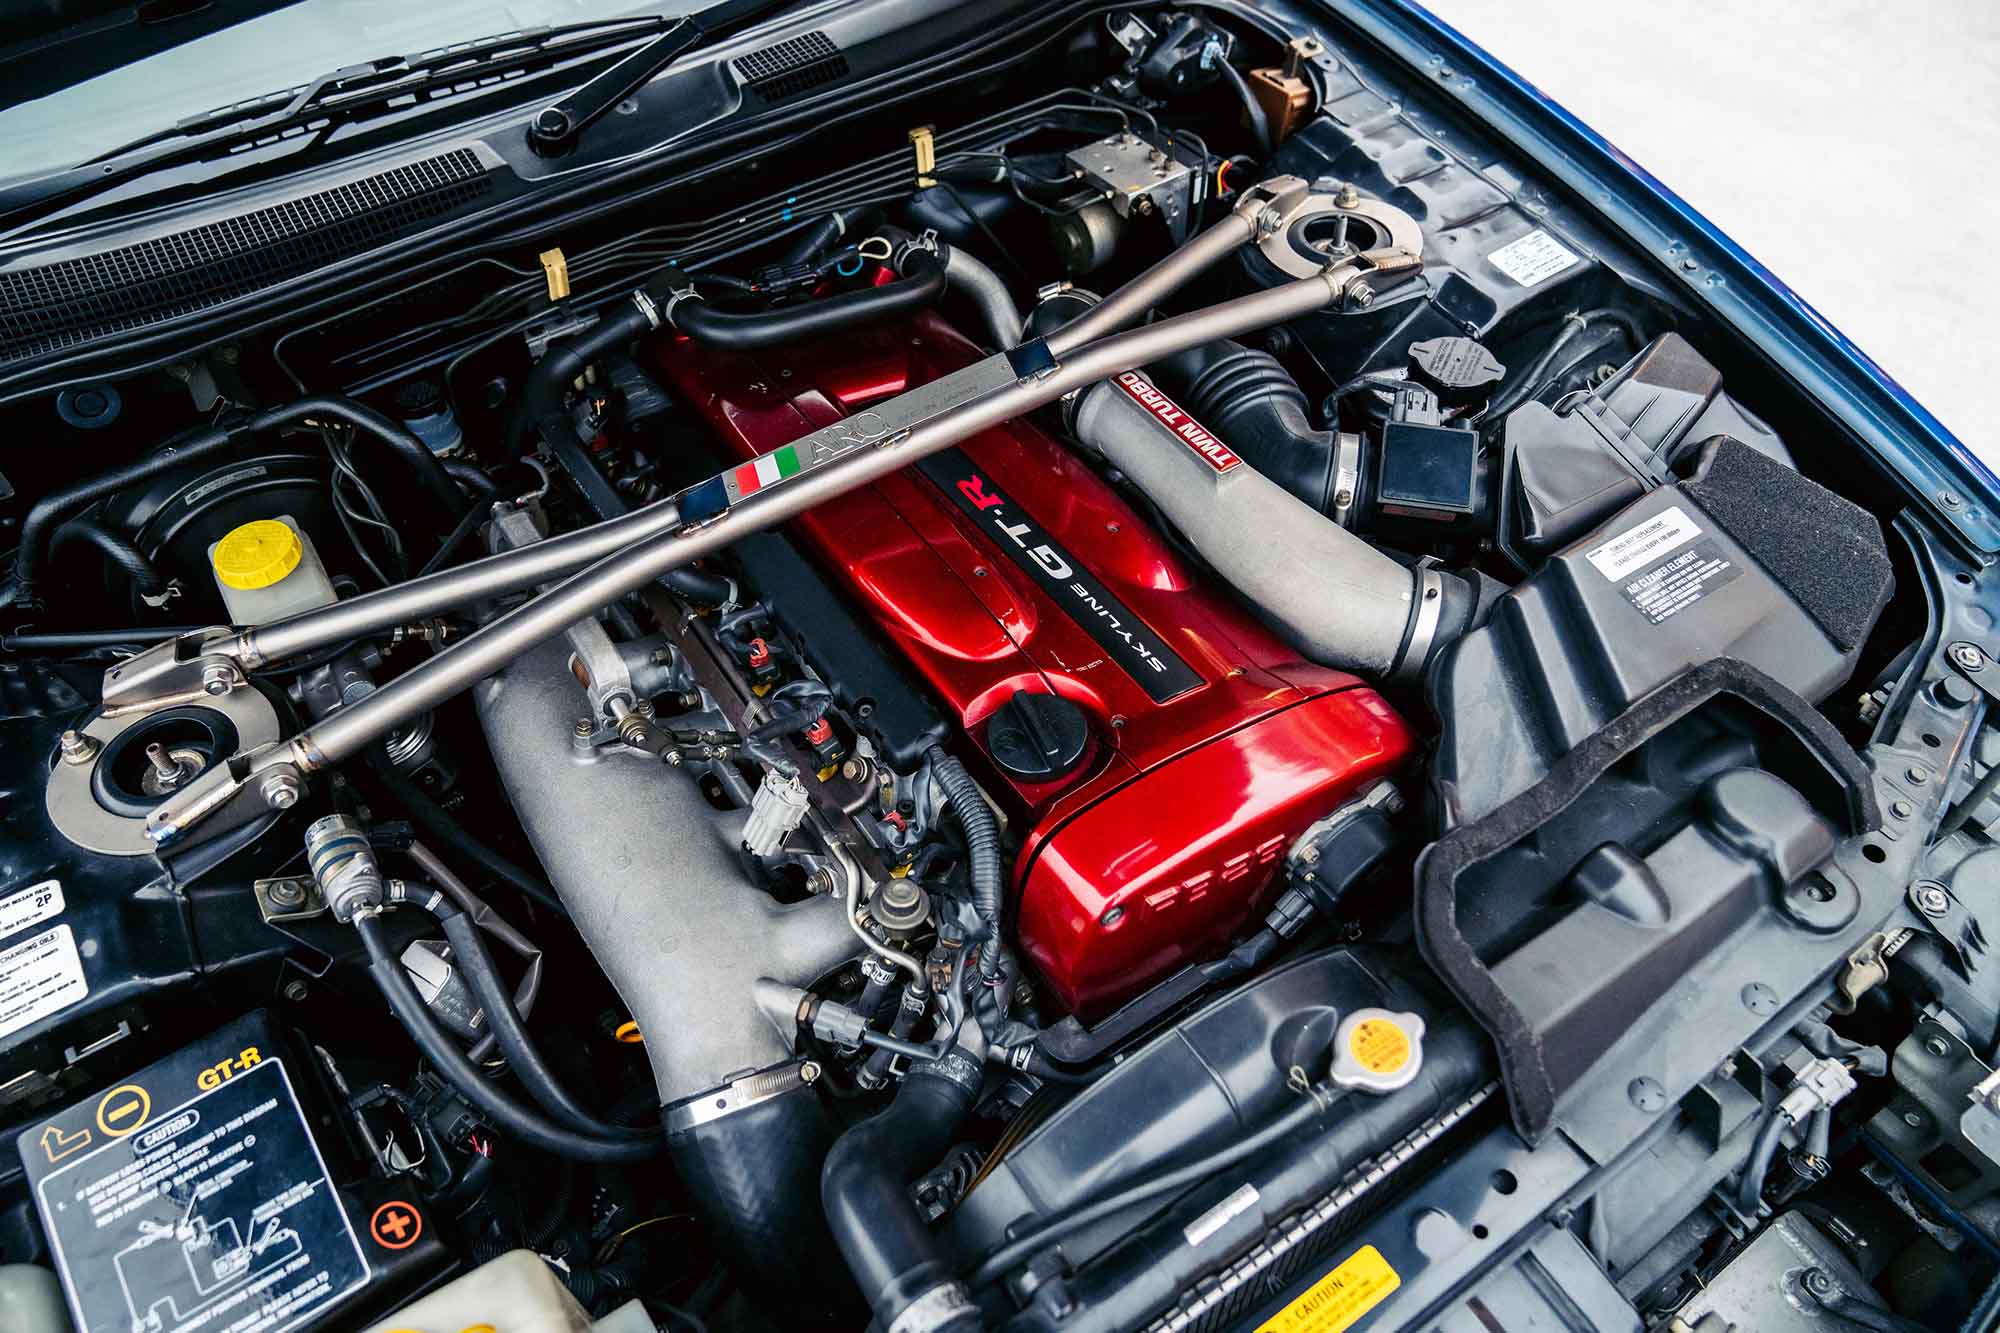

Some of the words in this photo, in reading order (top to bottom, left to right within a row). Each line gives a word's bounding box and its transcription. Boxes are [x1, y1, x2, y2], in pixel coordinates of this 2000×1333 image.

[1119, 372, 1177, 425] TURBO
[810, 412, 892, 465] ARC
[1178, 420, 1233, 466] TWIN
[956, 474, 1073, 580] GT-R
[1626, 582, 1641, 595] AIR
[1638, 566, 1671, 588] CLEANER
[1667, 550, 1699, 571] ELEMENT
[1070, 583, 1168, 673] SKYLINE
[35, 893, 53, 908] 2P
[198, 1046, 262, 1091] GT-R
[142, 1115, 191, 1146] CAUTION
[1295, 1279, 1344, 1320] CAUTION
